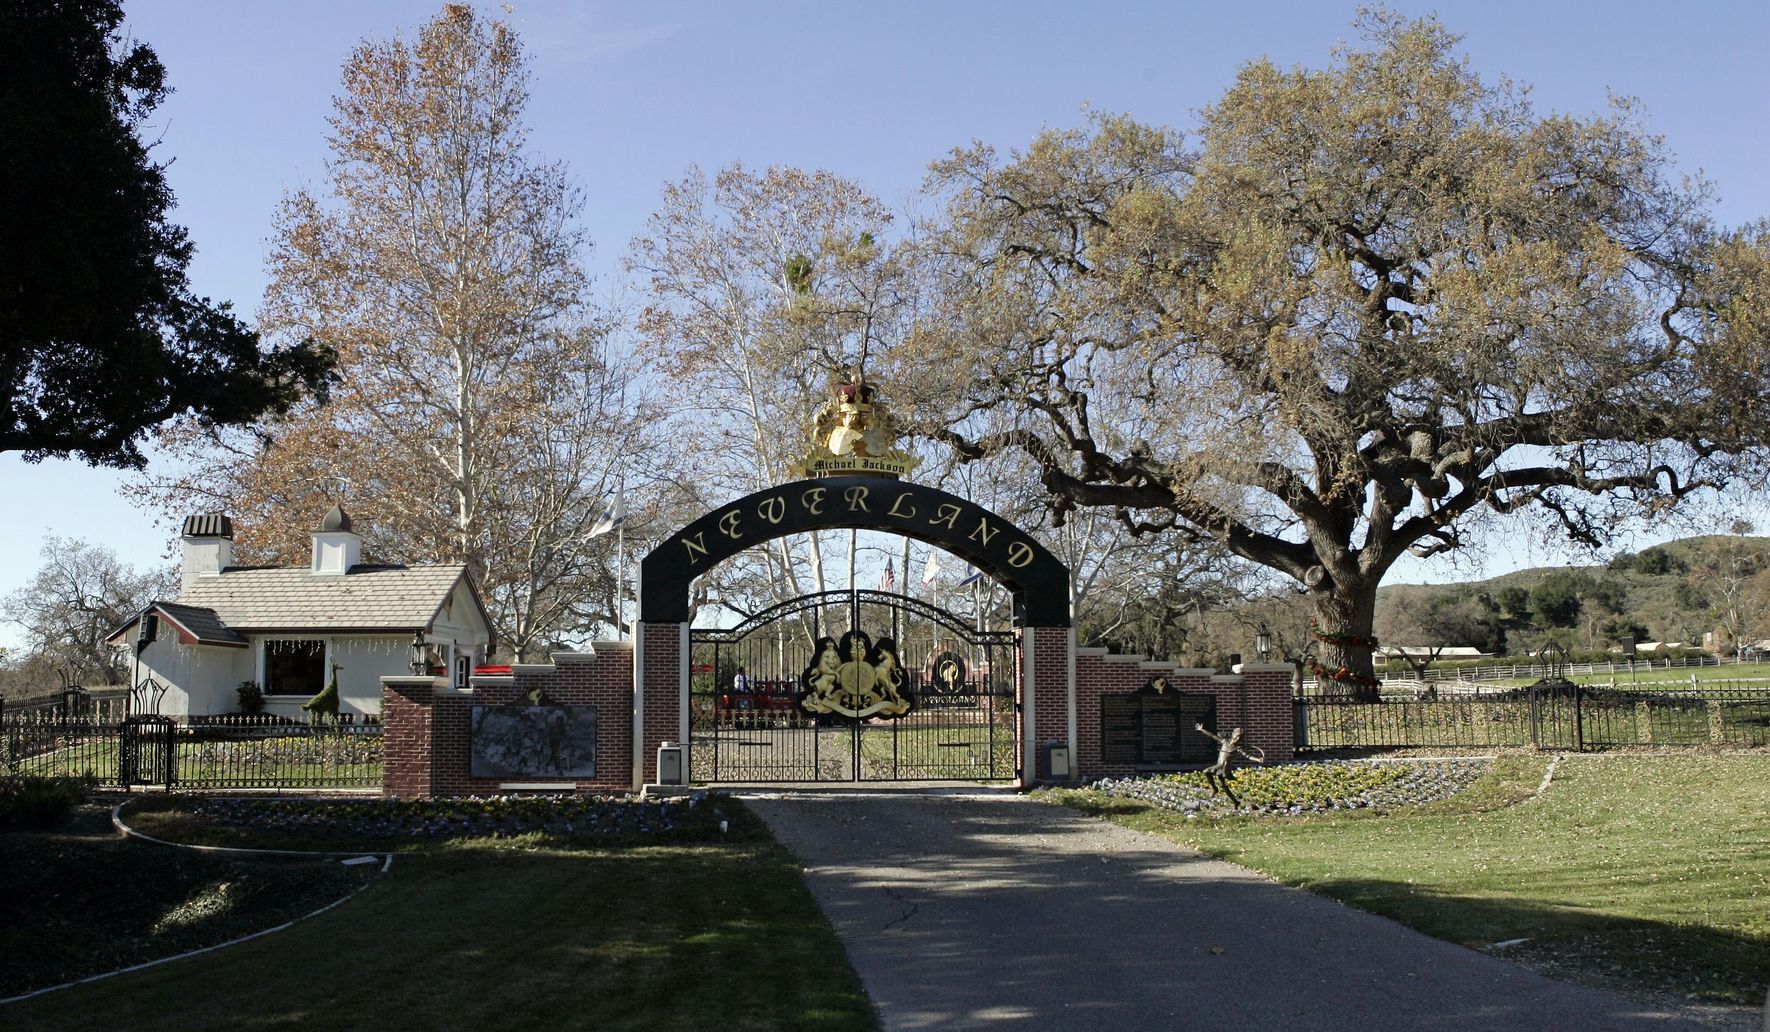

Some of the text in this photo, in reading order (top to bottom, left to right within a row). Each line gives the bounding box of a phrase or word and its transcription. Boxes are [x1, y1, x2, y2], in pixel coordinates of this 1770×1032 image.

[814, 458, 905, 473] Michael Jackson
[680, 485, 1035, 568] NEVERLAND
